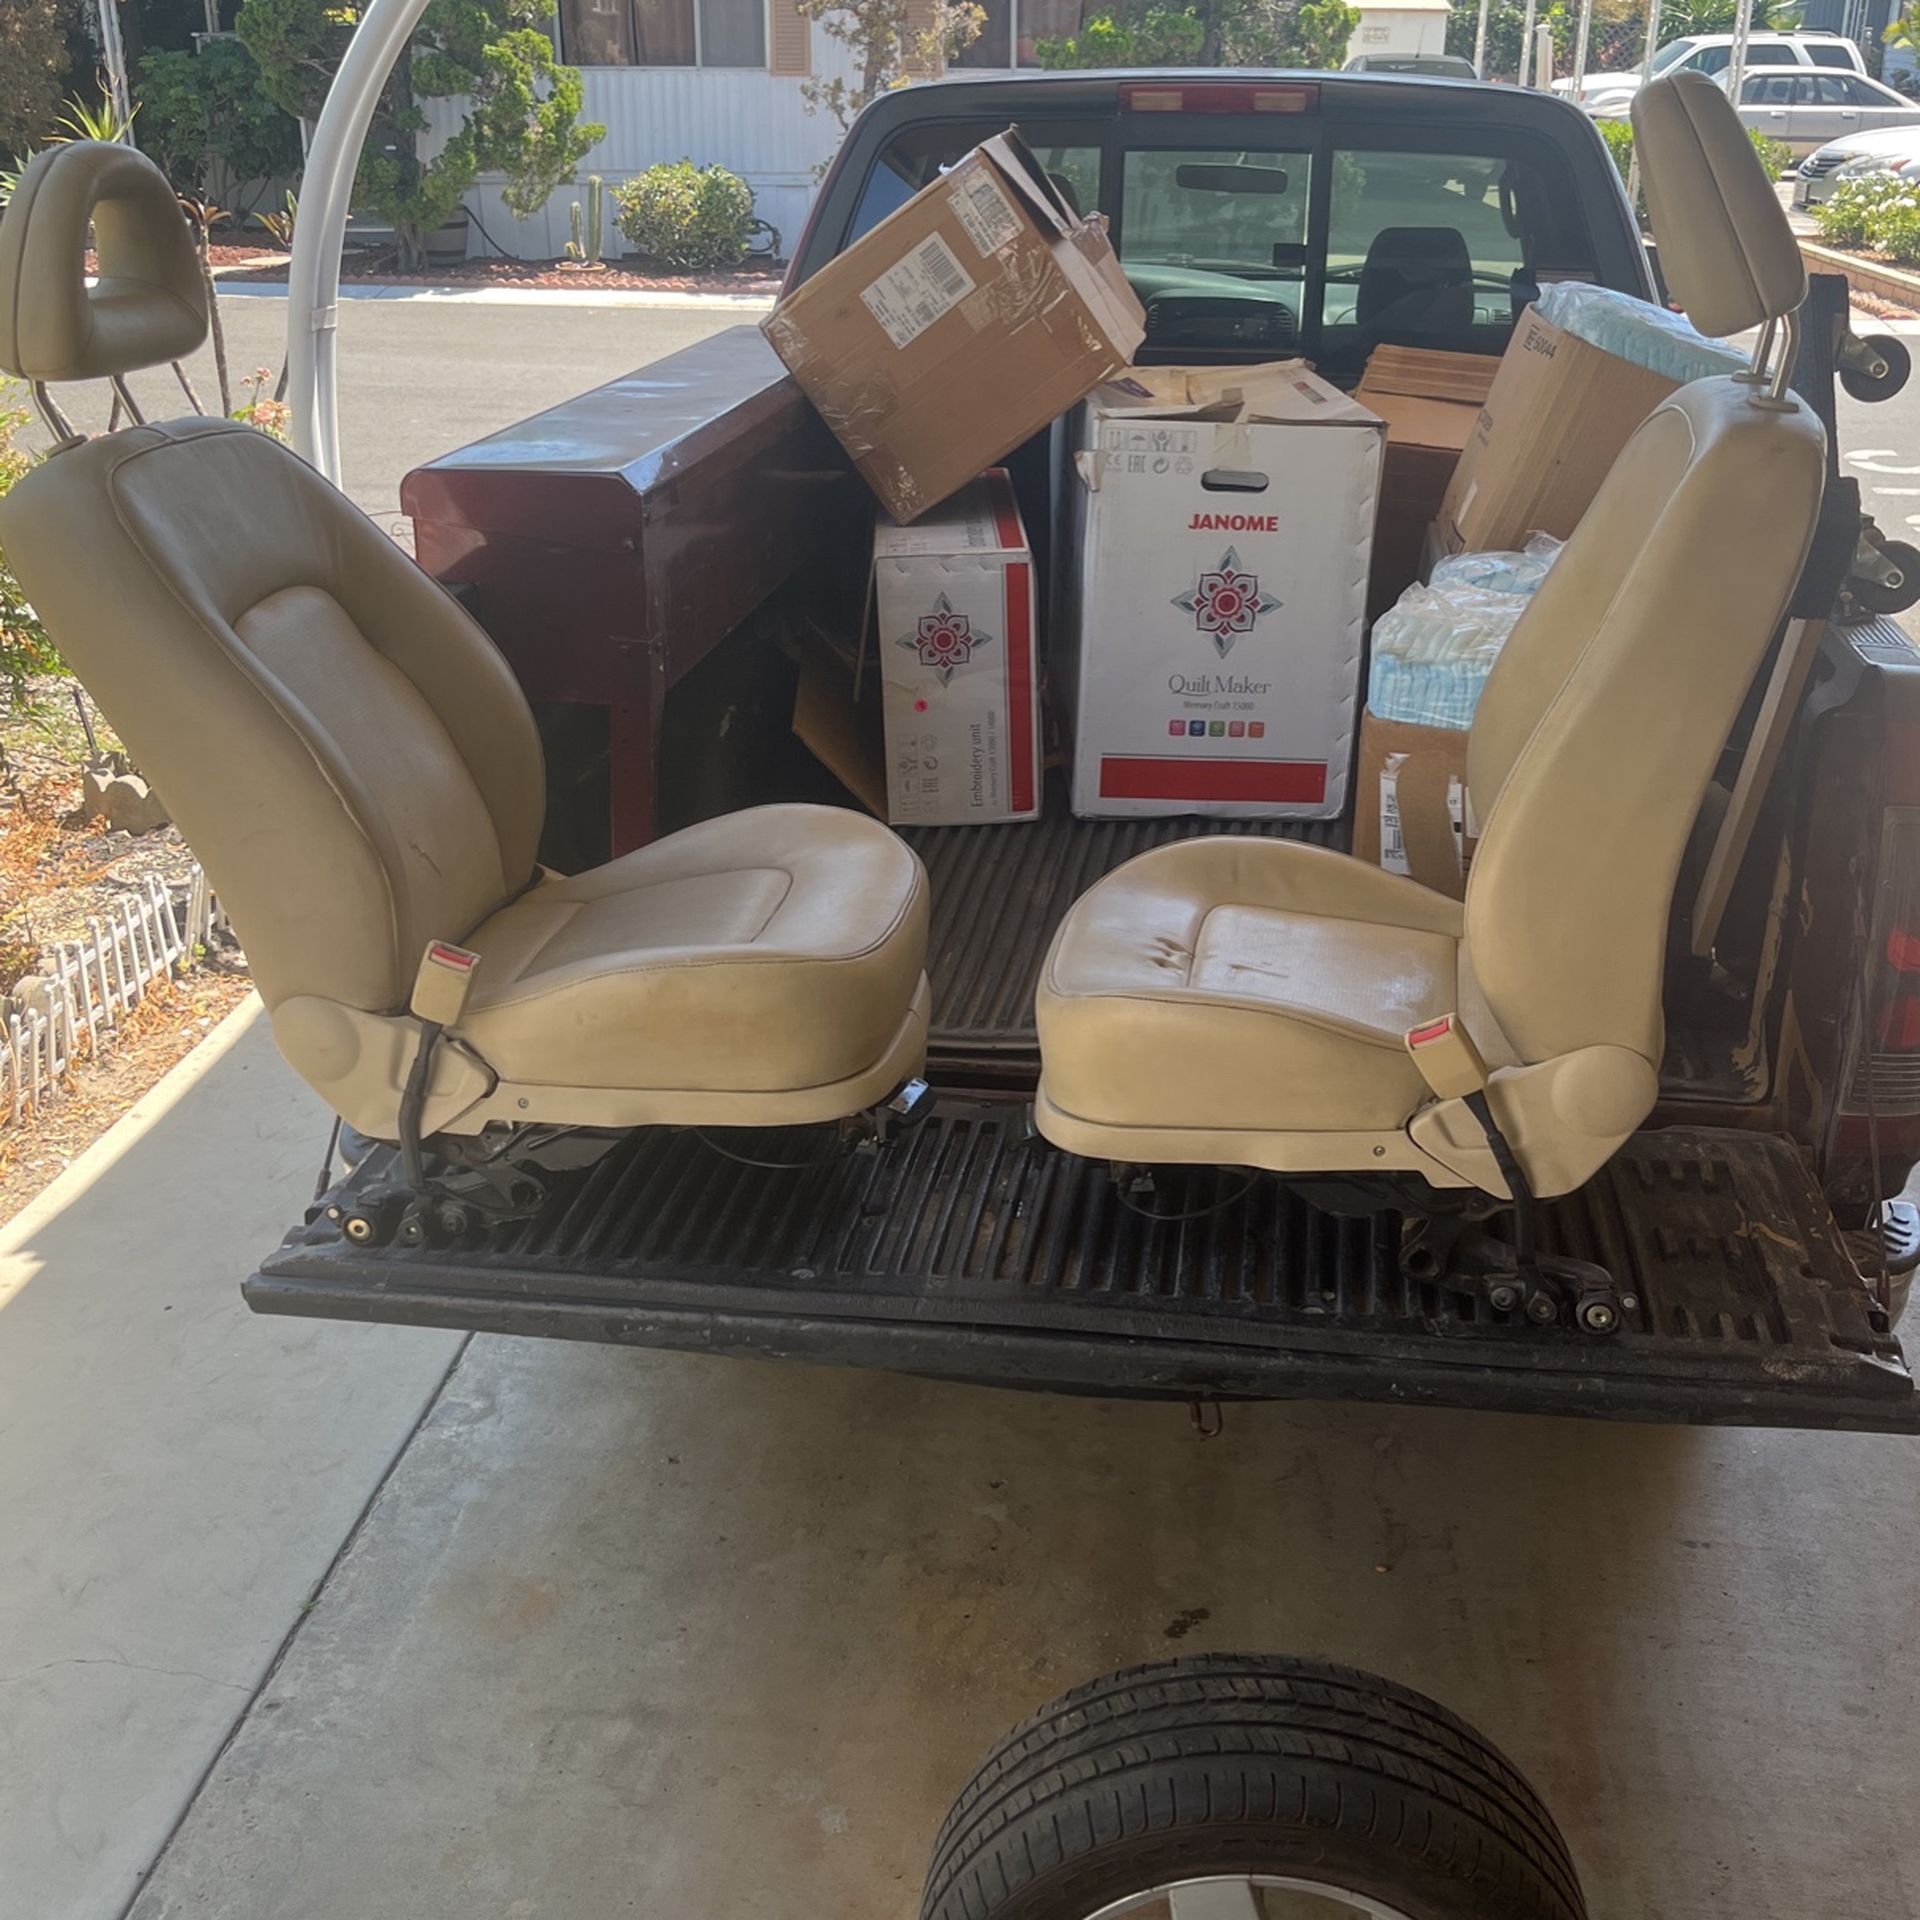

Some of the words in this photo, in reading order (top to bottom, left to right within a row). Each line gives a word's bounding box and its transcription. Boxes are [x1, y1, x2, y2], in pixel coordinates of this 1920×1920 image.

[1188, 513, 1279, 532] JANOME
[1168, 674, 1210, 697] Quilt
[1214, 675, 1271, 694] Maker
[968, 724, 981, 745] unit
[969, 747, 985, 807] Embroidery
